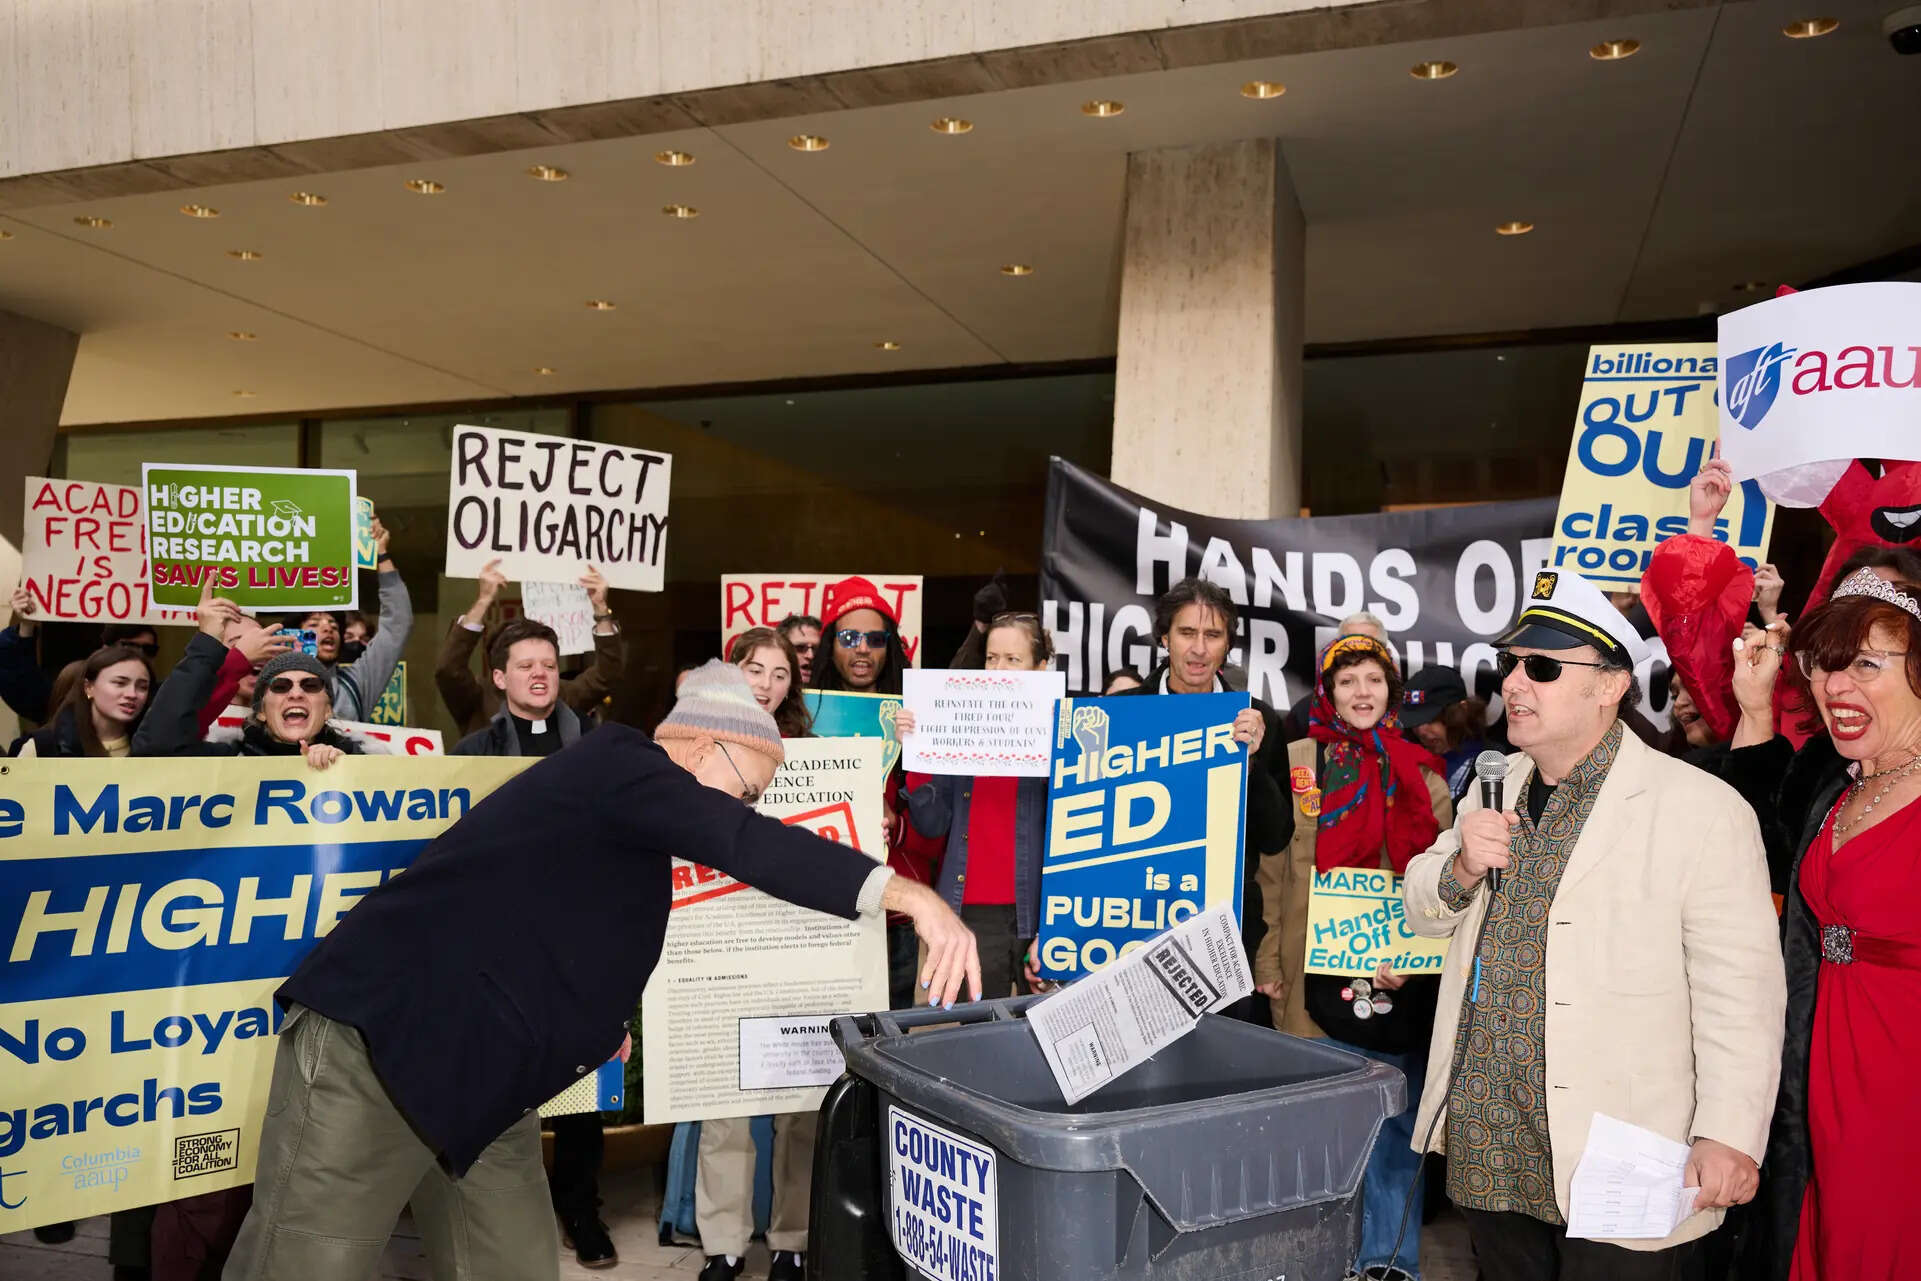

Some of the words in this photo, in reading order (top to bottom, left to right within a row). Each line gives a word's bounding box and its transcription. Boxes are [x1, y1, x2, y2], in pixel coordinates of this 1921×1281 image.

[1592, 352, 1717, 375] billiona
[1792, 345, 1921, 396] aau
[458, 432, 664, 504] REJECT
[1577, 423, 1716, 489] OU
[32, 483, 139, 518] ACAD
[151, 483, 262, 510] HIGHER
[152, 510, 316, 537] EDUCATION
[454, 496, 668, 566] OLIGARCHY
[152, 537, 309, 562] RESEARCH
[77, 555, 113, 579] IS
[154, 563, 240, 588] SAVES
[249, 567, 349, 588] LIVES!
[1136, 506, 1419, 631] HANDS
[26, 575, 198, 621] NEGOT
[1043, 600, 1291, 711] HIGR
[935, 700, 983, 709] REINSTATE
[989, 700, 1005, 709] THE
[954, 713, 983, 722] FIRED
[921, 725, 948, 734] FIGHT
[952, 725, 1006, 735] REPRESSION
[932, 738, 975, 747] WORKERS
[780, 759, 862, 771] ACADEMIC
[1053, 722, 1240, 790] HIGHER
[53, 784, 235, 835] Marc
[253, 779, 471, 826] Rowan
[764, 791, 854, 804] EDUCATION
[1049, 780, 1171, 858] ED
[1145, 866, 1171, 891] is
[1179, 873, 1198, 891] a
[1314, 871, 1386, 893] MARC
[9, 867, 405, 962] HIGHE
[1045, 895, 1199, 930] PUBLIC
[1314, 900, 1404, 944] Hands
[1219, 914, 1233, 948] COMPACT
[1349, 924, 1391, 955] Off
[1042, 936, 1147, 974] GO
[1202, 927, 1209, 937] IN
[1213, 962, 1228, 999] EDUCATION
[1216, 939, 1233, 980] EXCELLENCE
[1229, 945, 1238, 961] FOR
[1155, 948, 1208, 1008] REJECTED
[1232, 960, 1247, 992] ACADEMIC
[110, 998, 286, 1055] Loyal
[781, 1025, 829, 1035] WARNIN
[0, 1078, 223, 1157] garchs
[61, 1145, 141, 1170] Columbia
[178, 1154, 200, 1166] FOR
[202, 1151, 221, 1163] ALL
[179, 1135, 223, 1150] STRONG
[179, 1141, 233, 1157] ECONOMY
[895, 1120, 989, 1195] COUNTY
[73, 1166, 129, 1192] aaup
[178, 1157, 232, 1175] COALITION
[901, 1164, 984, 1240] WASTE
[895, 1205, 994, 1281] 1-888-54-WASTE
